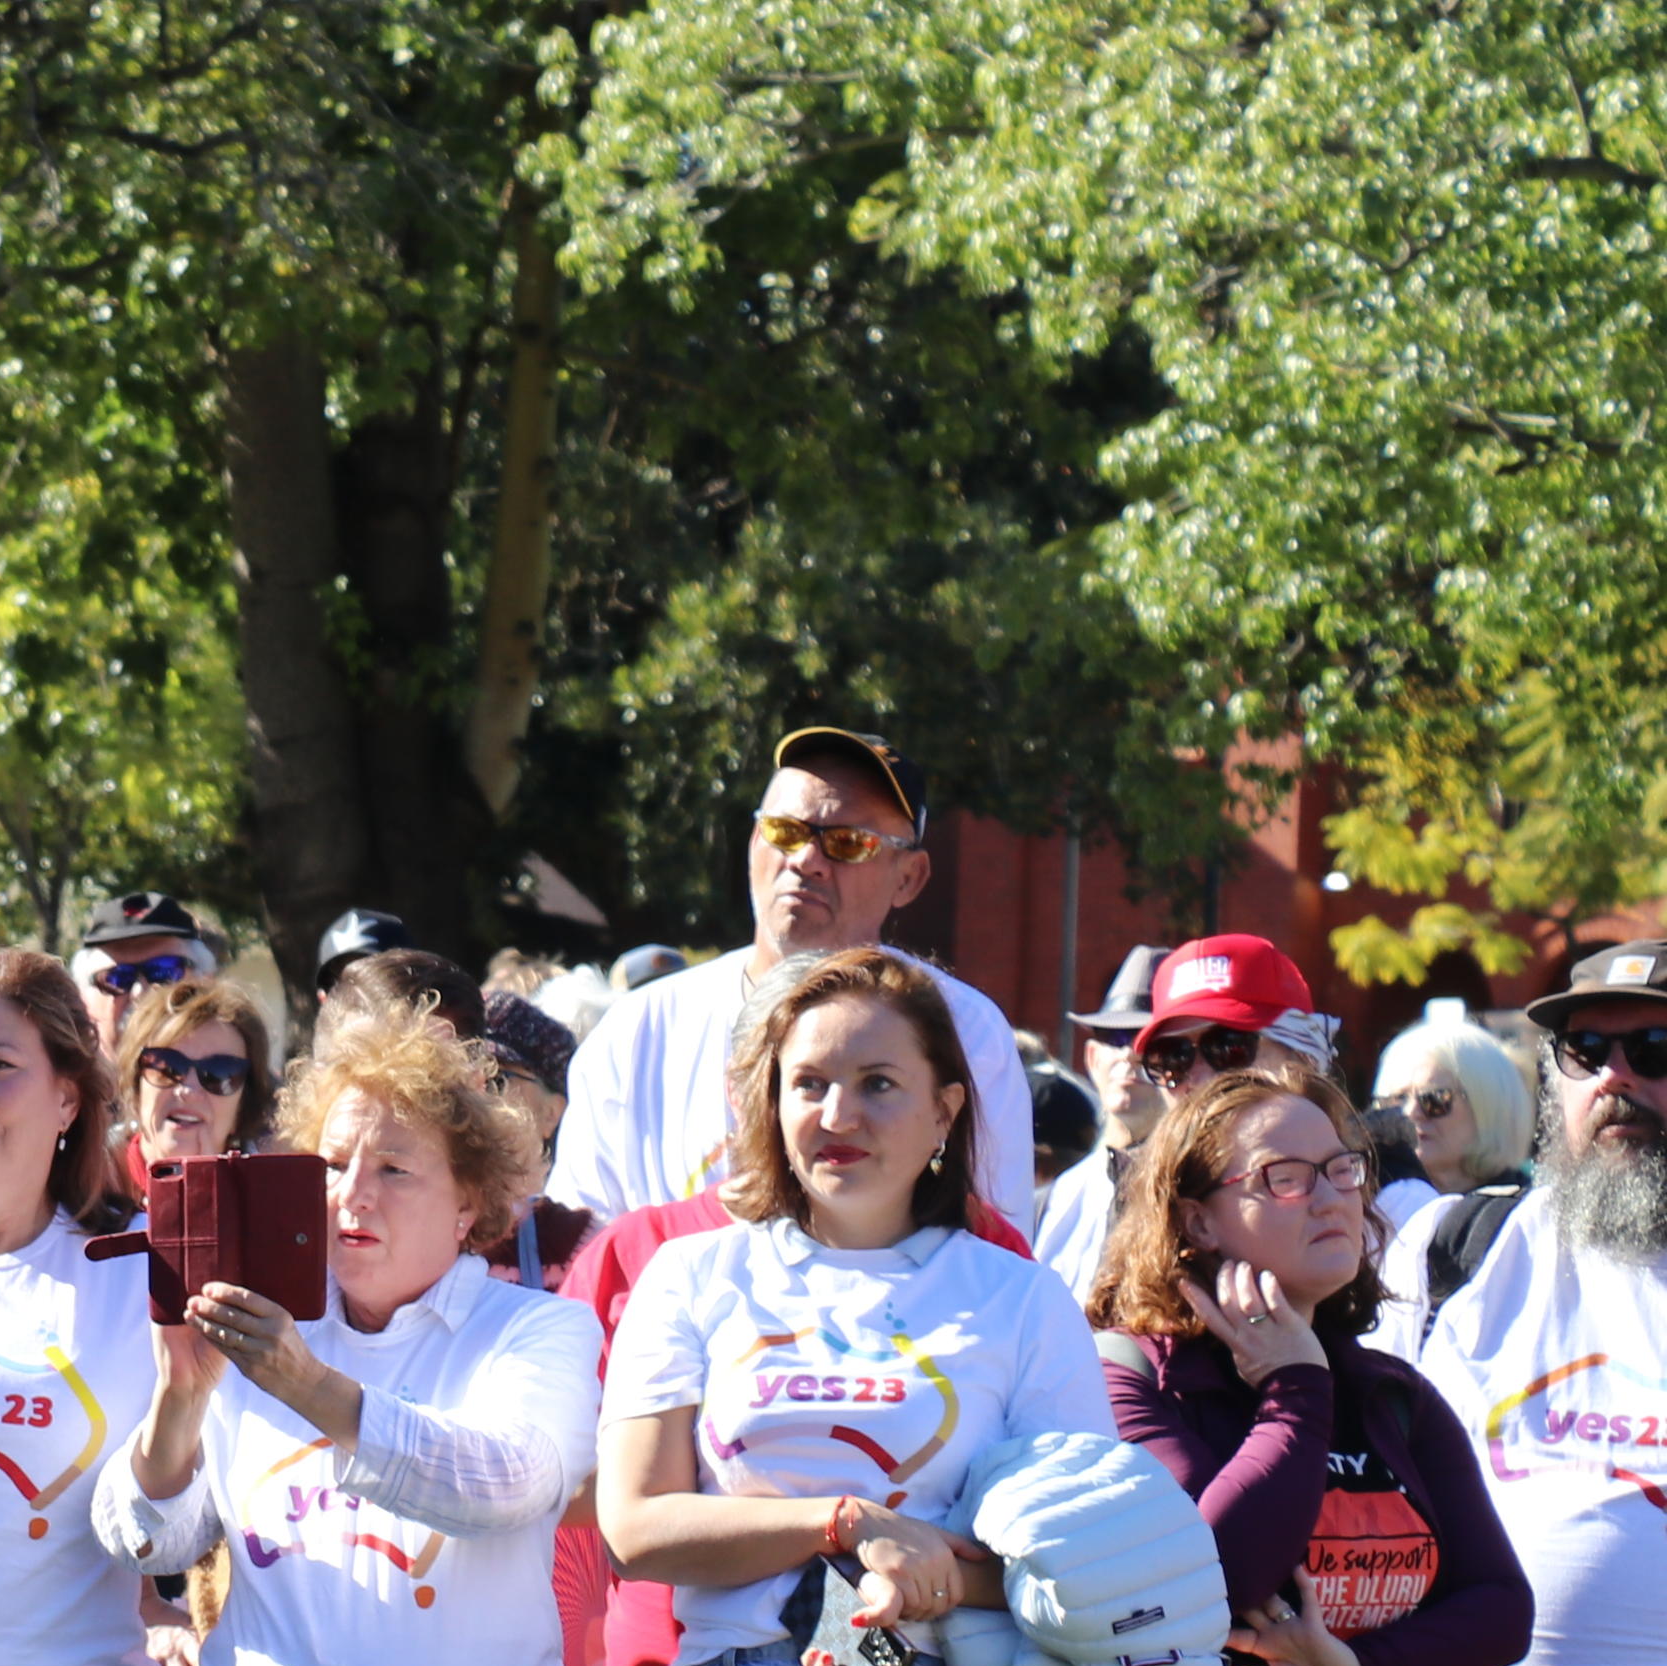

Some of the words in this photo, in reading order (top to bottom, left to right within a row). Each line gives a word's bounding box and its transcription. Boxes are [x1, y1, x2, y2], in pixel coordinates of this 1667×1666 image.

[749, 1374, 907, 1409] yes23
[1539, 1409, 1667, 1447] yes2
[1343, 1537, 1437, 1578] support
[1354, 1574, 1427, 1606] ULURU
